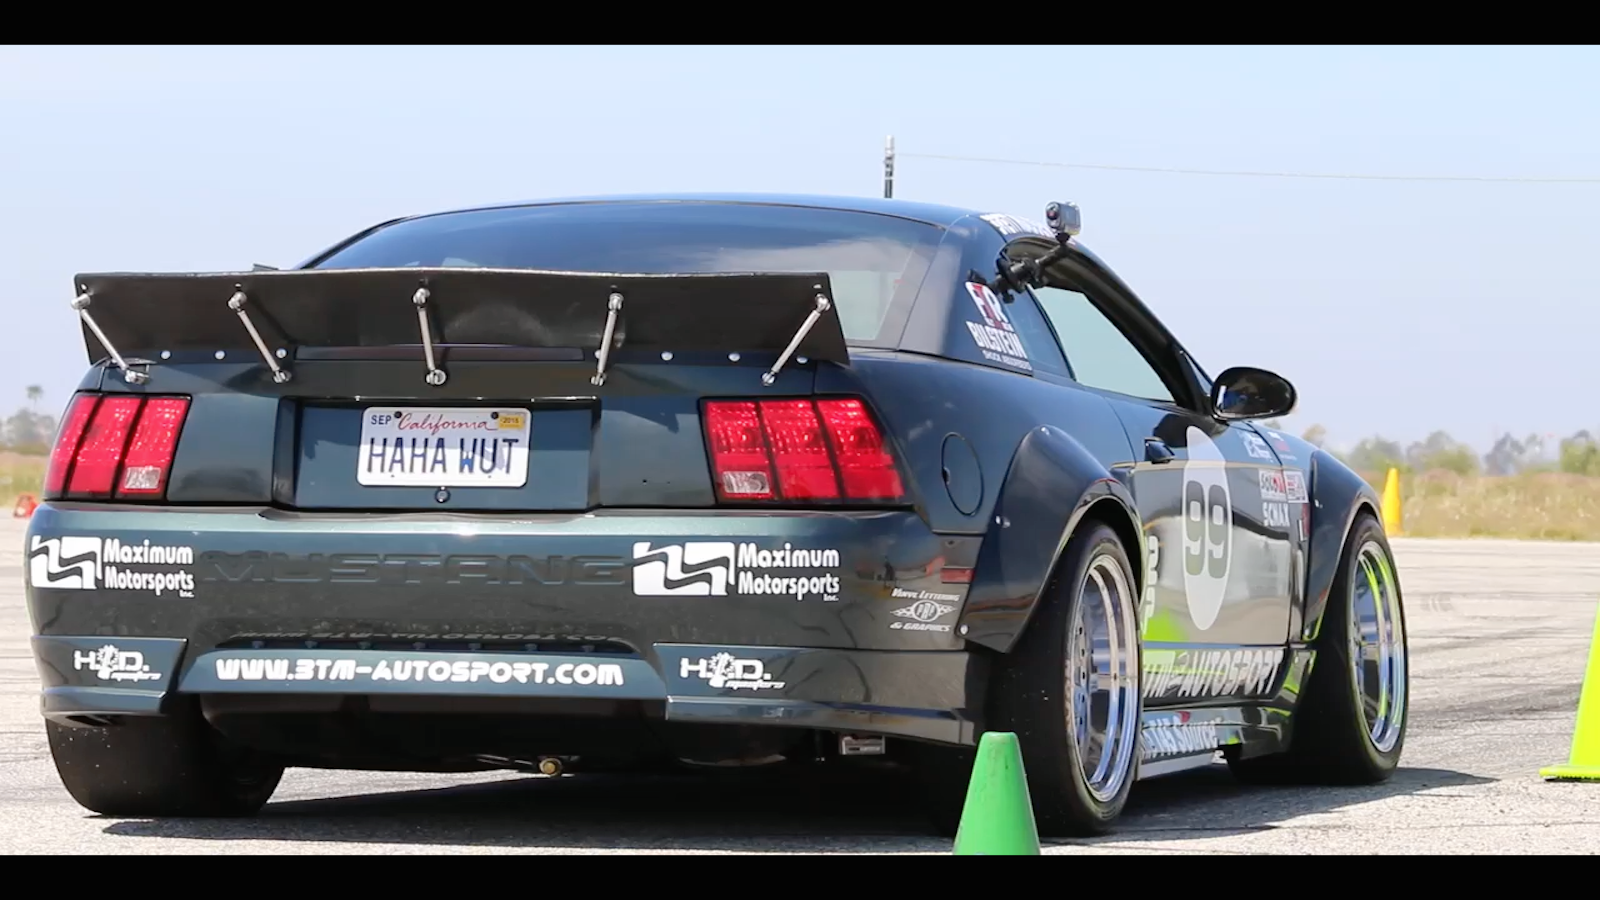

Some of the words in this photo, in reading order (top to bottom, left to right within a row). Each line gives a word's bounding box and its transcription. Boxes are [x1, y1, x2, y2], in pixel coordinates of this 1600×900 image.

[965, 321, 1028, 359] BILSTEIN
[371, 415, 391, 425] SEP
[398, 413, 499, 435] California
[367, 437, 447, 473] HAHA
[459, 437, 519, 474] WUT
[1184, 480, 1229, 579] 99
[103, 538, 193, 564] Maximum
[737, 542, 840, 568] Maximum
[104, 566, 194, 596] Motorsports
[201, 550, 625, 586] MUSTANG
[738, 570, 840, 601] Motorsports
